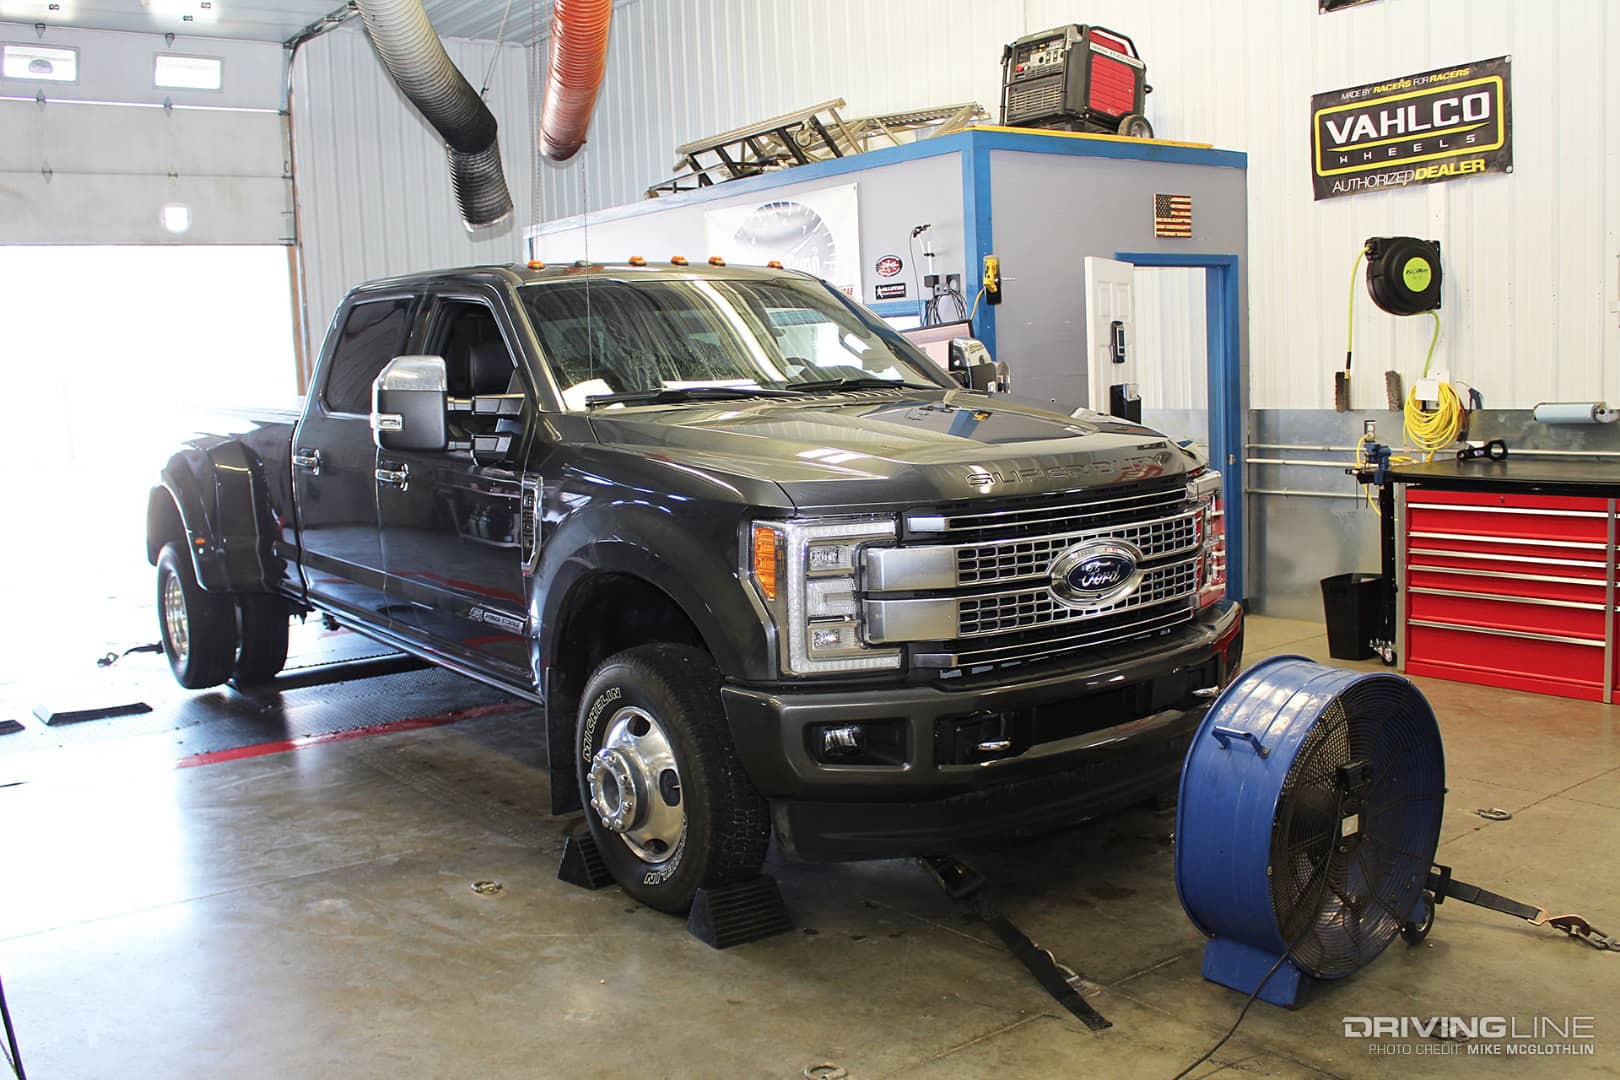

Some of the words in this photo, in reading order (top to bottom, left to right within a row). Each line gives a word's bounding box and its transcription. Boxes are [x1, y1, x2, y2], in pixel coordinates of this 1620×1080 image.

[1341, 89, 1361, 100] MADE
[1361, 87, 1372, 97] BY
[1373, 79, 1413, 94] RACERS
[1413, 76, 1429, 86] FOR
[1429, 67, 1471, 83] RACERS
[1325, 91, 1490, 145] VAHLCO
[1339, 134, 1476, 164] WHEELS
[1081, 560, 1121, 587] Ford
[583, 686, 622, 763] MICHELIN
